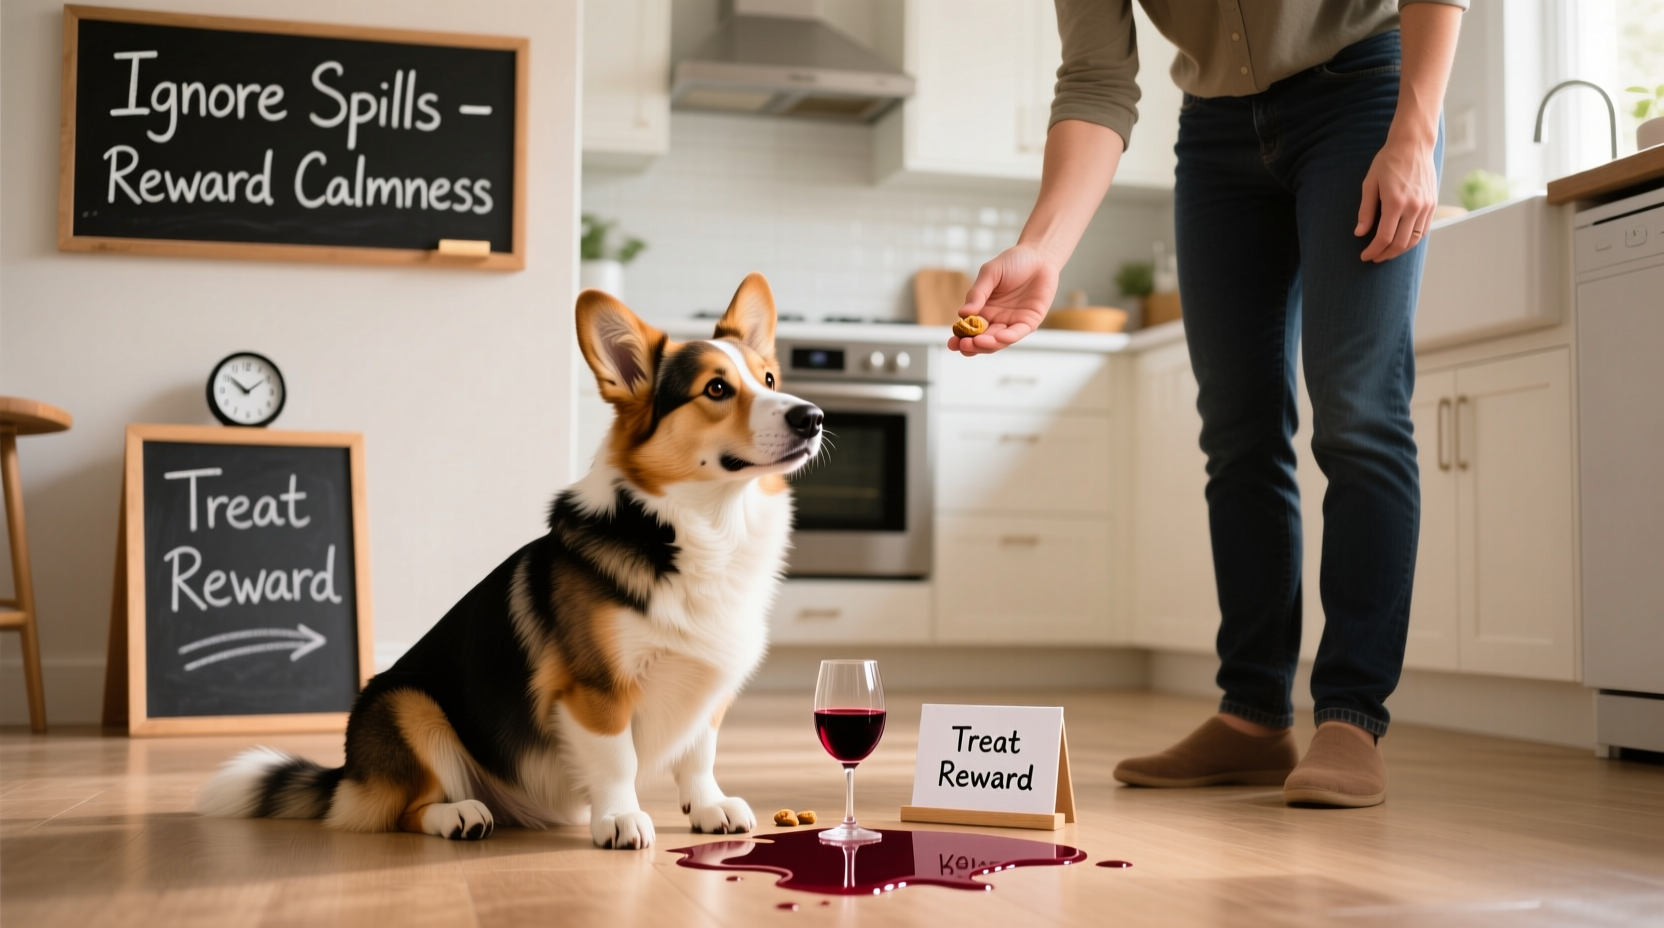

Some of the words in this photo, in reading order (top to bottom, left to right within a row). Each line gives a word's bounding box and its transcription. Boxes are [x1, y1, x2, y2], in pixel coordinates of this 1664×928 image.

[110, 51, 287, 143] Ignore
[309, 61, 442, 150] Spills
[103, 146, 274, 206] Reward
[294, 151, 494, 215] Calmness
[164, 467, 310, 532] Treat
[163, 545, 343, 612] Reward
[952, 725, 1021, 754] Treat
[938, 760, 1034, 791] Reward
